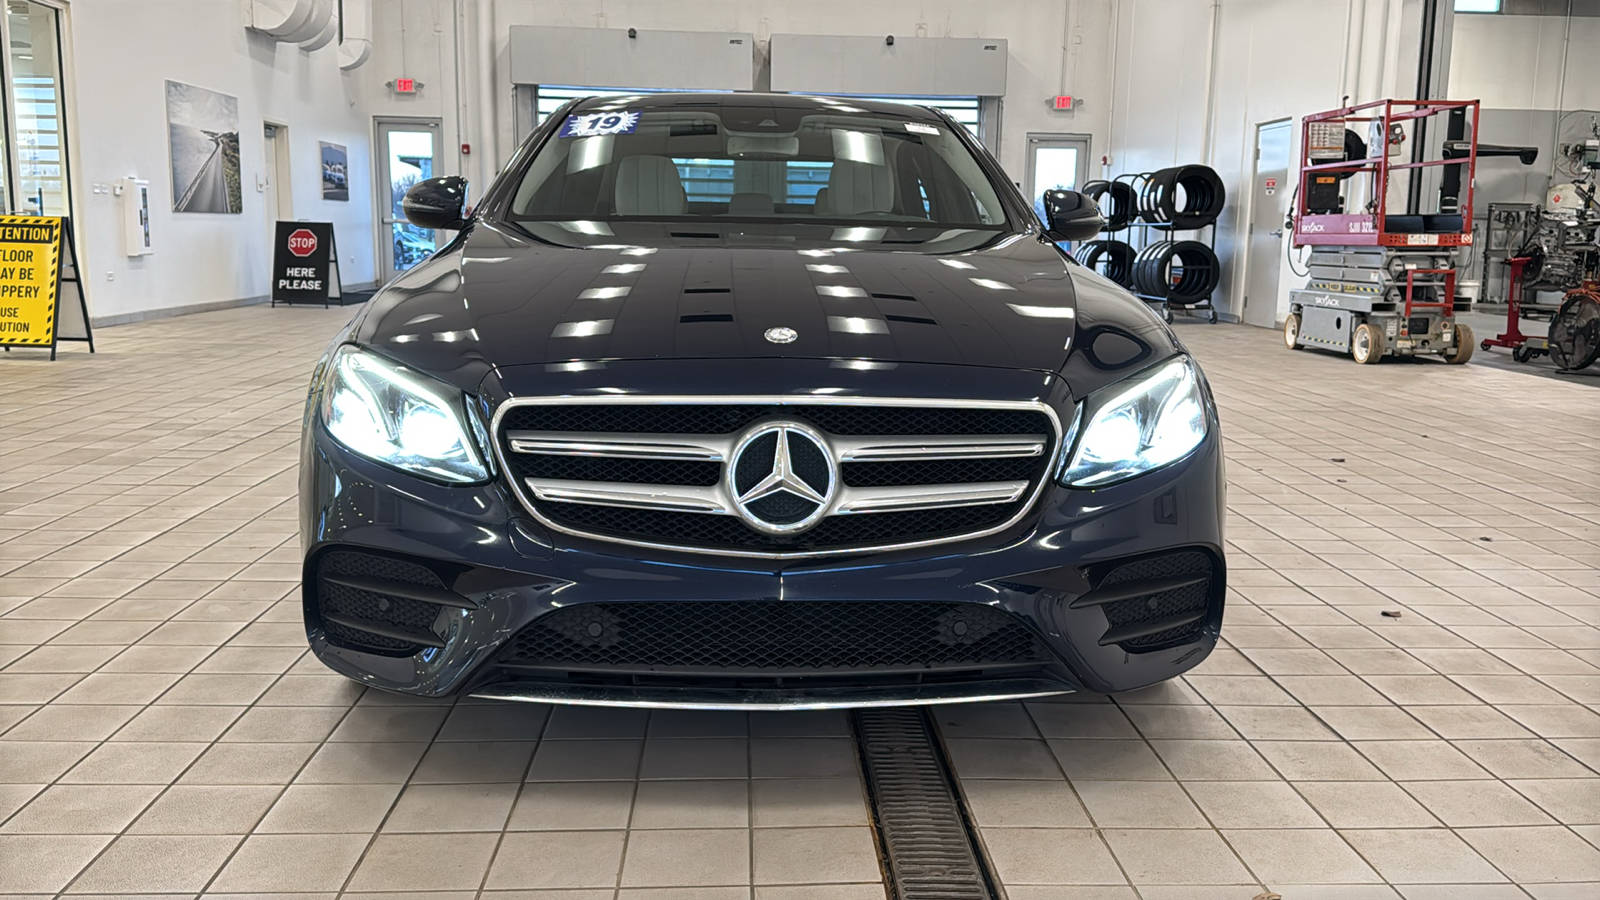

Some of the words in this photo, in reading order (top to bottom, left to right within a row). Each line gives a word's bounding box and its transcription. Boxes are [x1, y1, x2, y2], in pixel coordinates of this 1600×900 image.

[397, 78, 414, 92] EXIT
[1056, 96, 1072, 109] EXIT
[588, 115, 621, 130] 19
[0, 226, 50, 241] TENTION
[1301, 221, 1325, 234] SKYJACK
[290, 237, 316, 249] STOP
[19, 267, 35, 281] BE
[286, 266, 316, 278] HERE
[0, 284, 40, 299] PPERY
[278, 279, 322, 291] PLEASE
[1315, 294, 1340, 308] SKYJACK
[0, 307, 20, 318] USE
